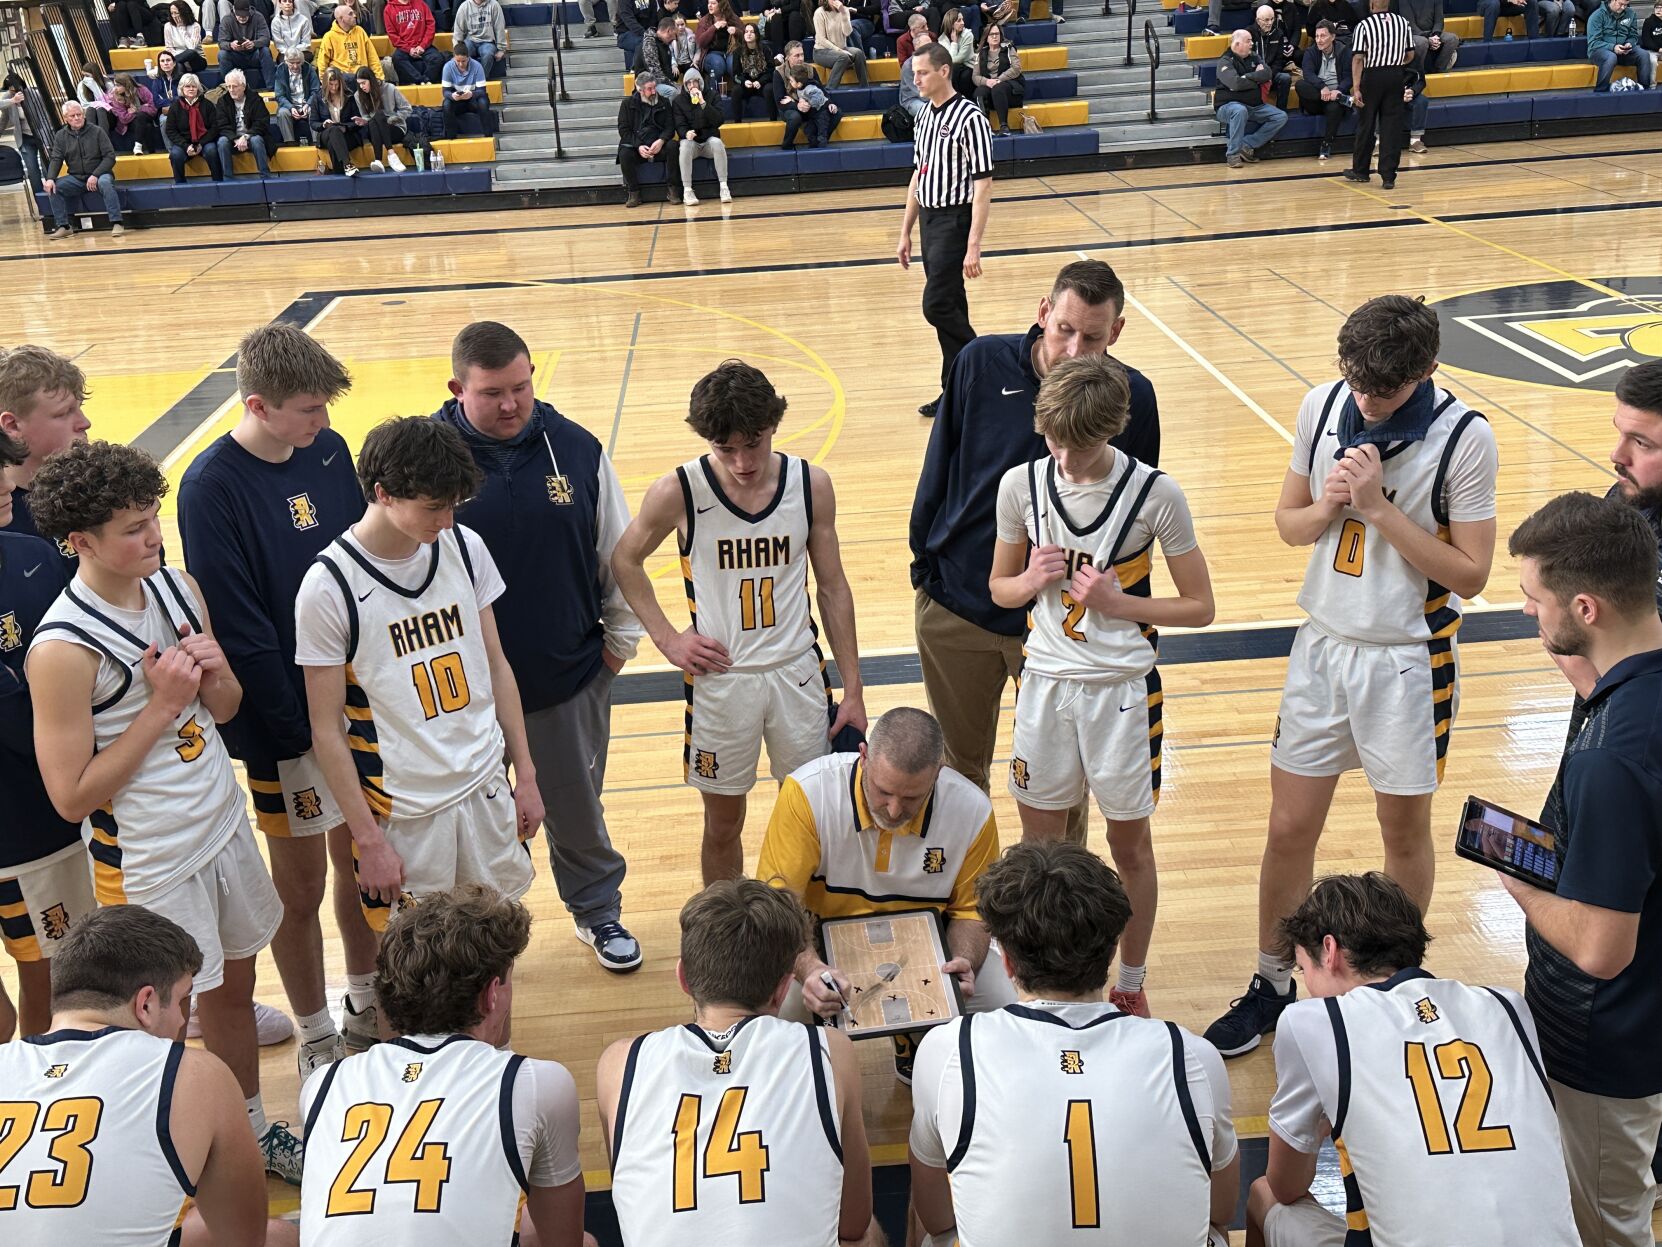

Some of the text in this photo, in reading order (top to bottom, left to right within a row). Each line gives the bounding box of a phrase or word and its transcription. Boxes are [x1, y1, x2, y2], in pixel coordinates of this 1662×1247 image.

[717, 535, 791, 570] RHAM
[1333, 518, 1366, 577] 0
[388, 604, 465, 658] RHAM
[738, 576, 776, 631] 11
[1061, 589, 1088, 642] 2
[411, 651, 471, 721] 10
[1404, 1038, 1516, 1155] 12
[0, 1096, 104, 1210] 23
[325, 1098, 452, 1218] 24
[671, 1086, 770, 1213] 14
[1063, 1099, 1100, 1229] 1
